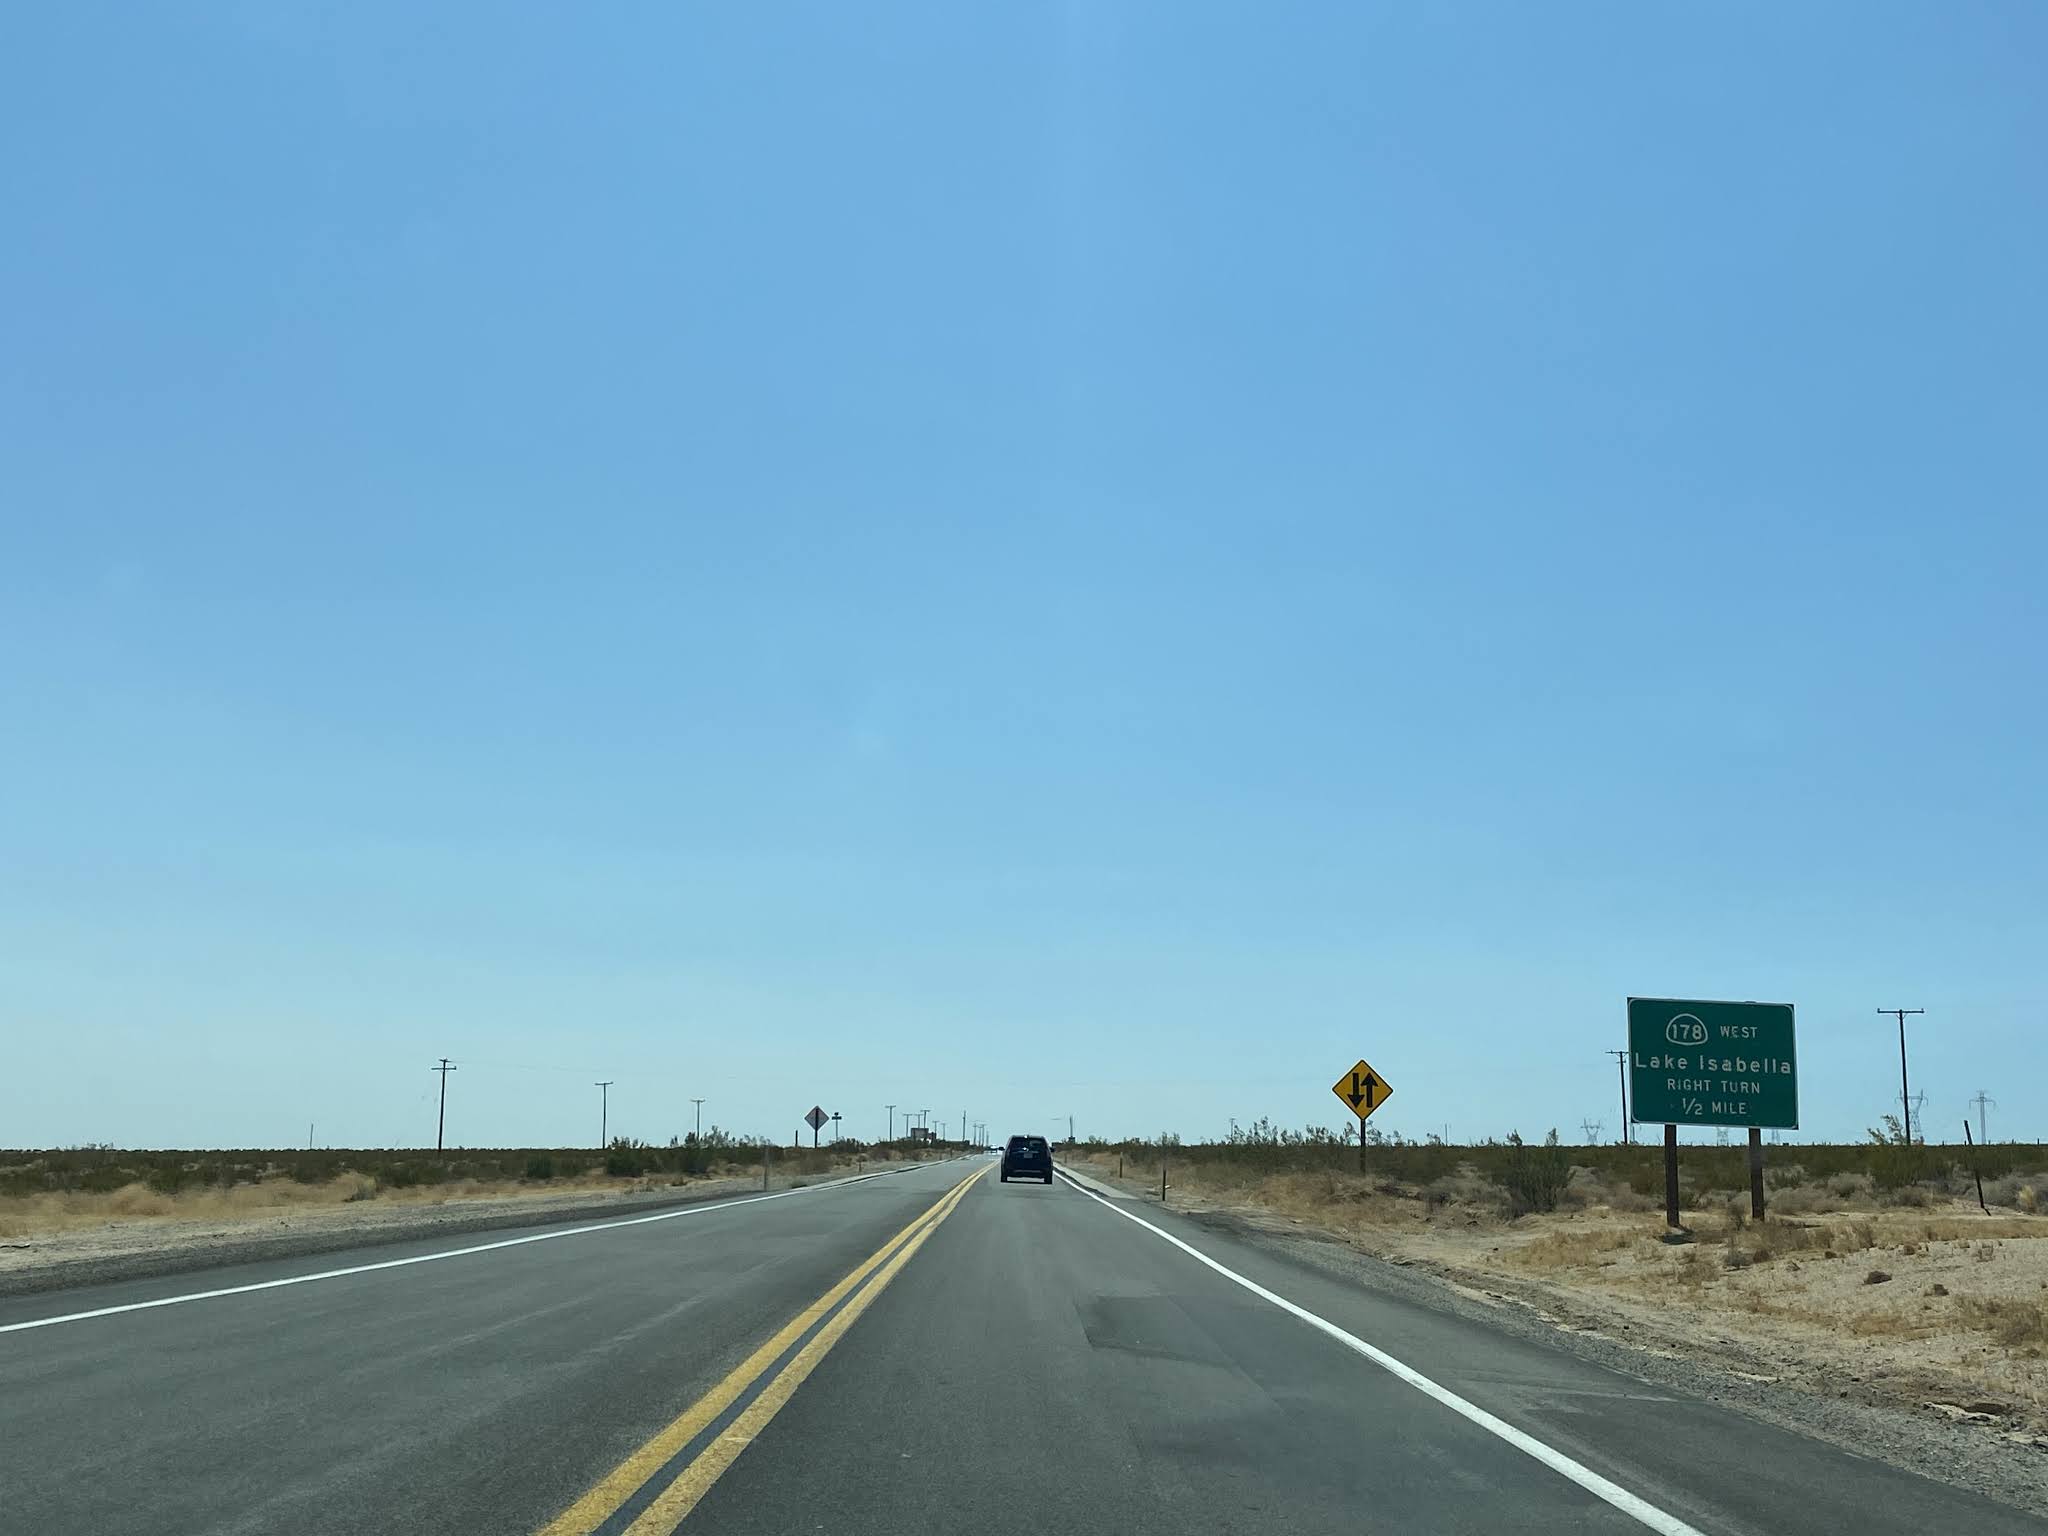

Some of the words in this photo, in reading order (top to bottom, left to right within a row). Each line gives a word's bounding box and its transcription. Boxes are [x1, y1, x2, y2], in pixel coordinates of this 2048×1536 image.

[1672, 1024, 1702, 1040] 178
[1720, 1025, 1758, 1039] WEST
[1635, 1052, 1688, 1070] Lake
[1699, 1055, 1791, 1074] Isabella
[1667, 1078, 1711, 1092] RIGHT
[1721, 1080, 1760, 1094] TURN
[1712, 1101, 1747, 1115] MILE
